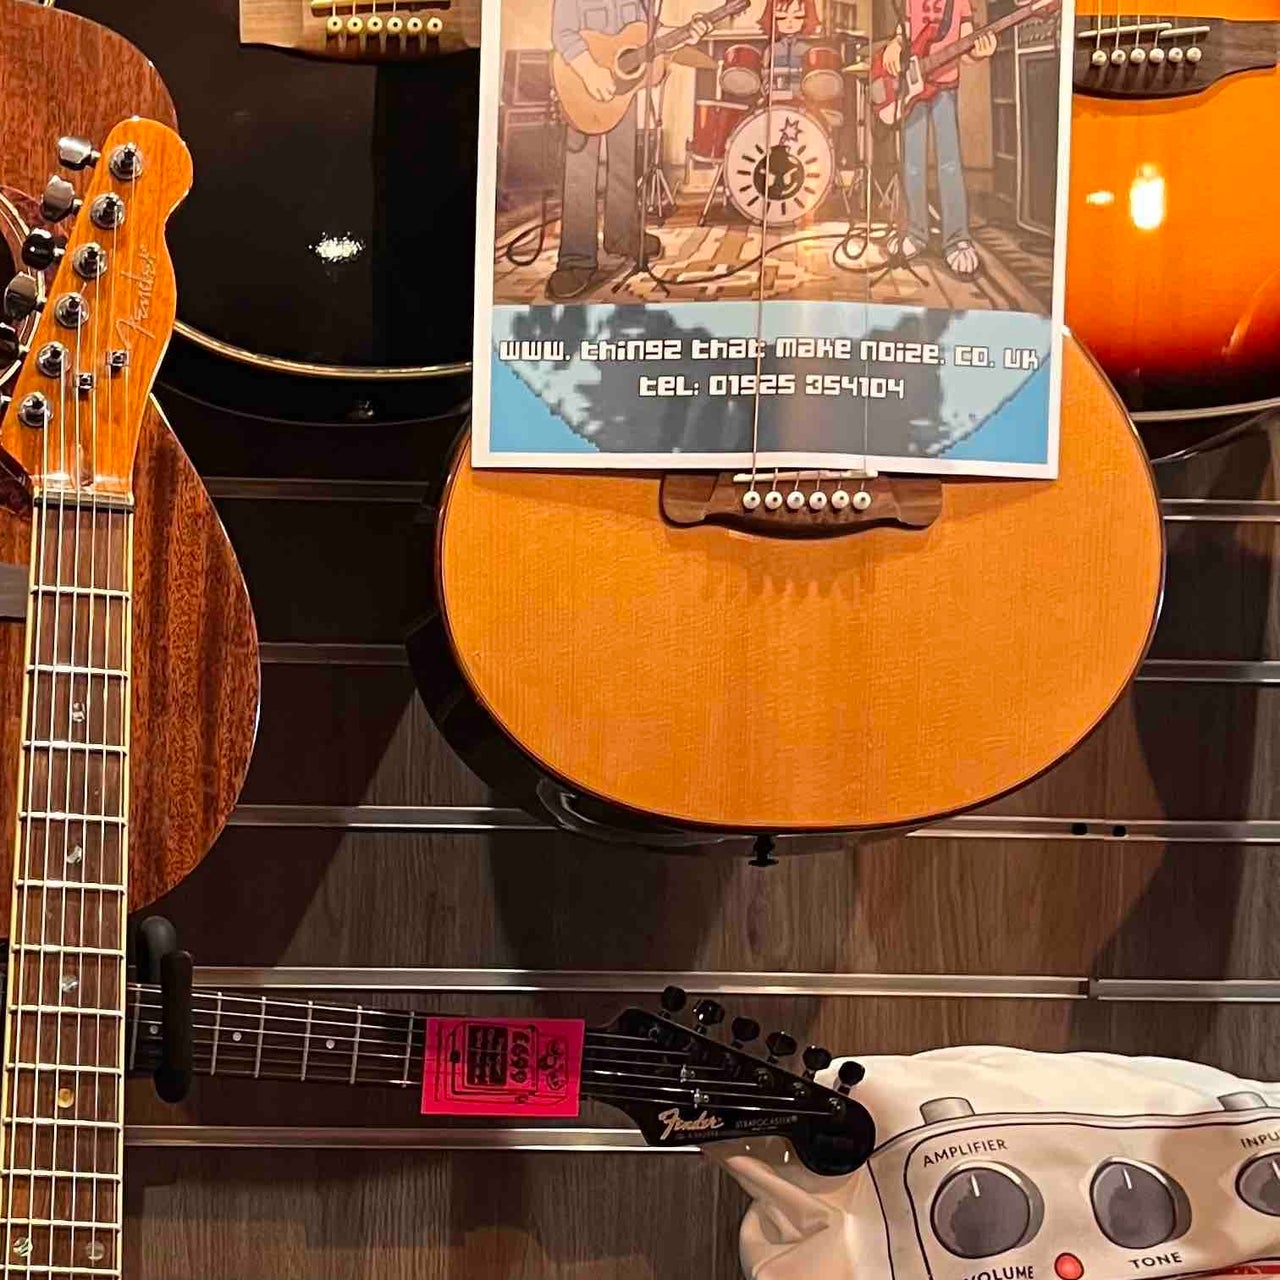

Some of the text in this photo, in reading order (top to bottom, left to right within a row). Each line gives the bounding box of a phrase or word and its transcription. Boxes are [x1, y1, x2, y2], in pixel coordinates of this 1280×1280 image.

[115, 244, 156, 350] Fender
[691, 338, 766, 360] that
[775, 337, 852, 359] make
[708, 374, 796, 396] 01925
[805, 374, 905, 400] 354104
[658, 1107, 724, 1140] Fender
[923, 1138, 1008, 1168] AMPLIFIER
[1240, 1131, 1280, 1149] INPU
[1128, 1252, 1183, 1270] TONE
